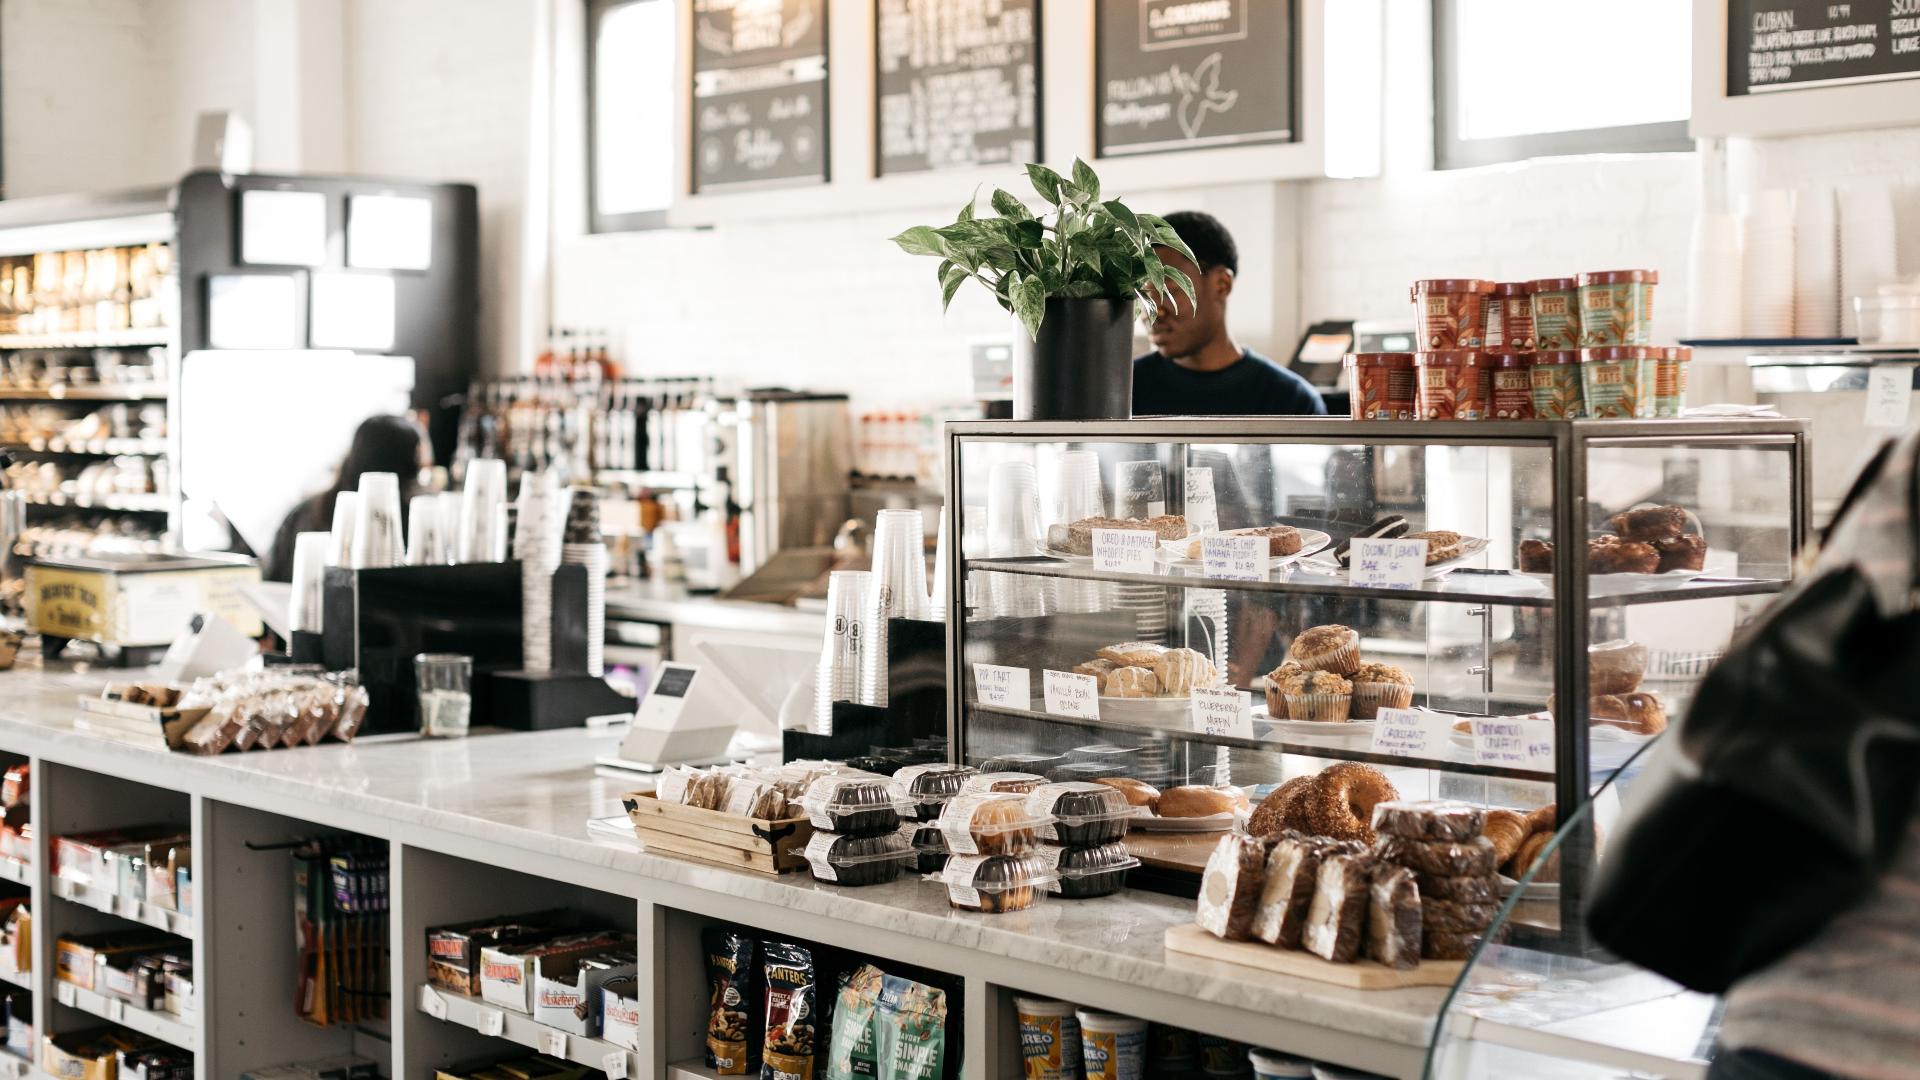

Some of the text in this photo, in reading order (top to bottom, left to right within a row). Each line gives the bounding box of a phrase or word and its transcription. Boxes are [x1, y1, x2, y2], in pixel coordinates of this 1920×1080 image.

[1753, 10, 1795, 31] CUBAN
[1204, 537, 1256, 549] CHOCOLATE CHIP
[895, 1039, 938, 1067] SIMPLE
[1083, 1048, 1109, 1061] REO
